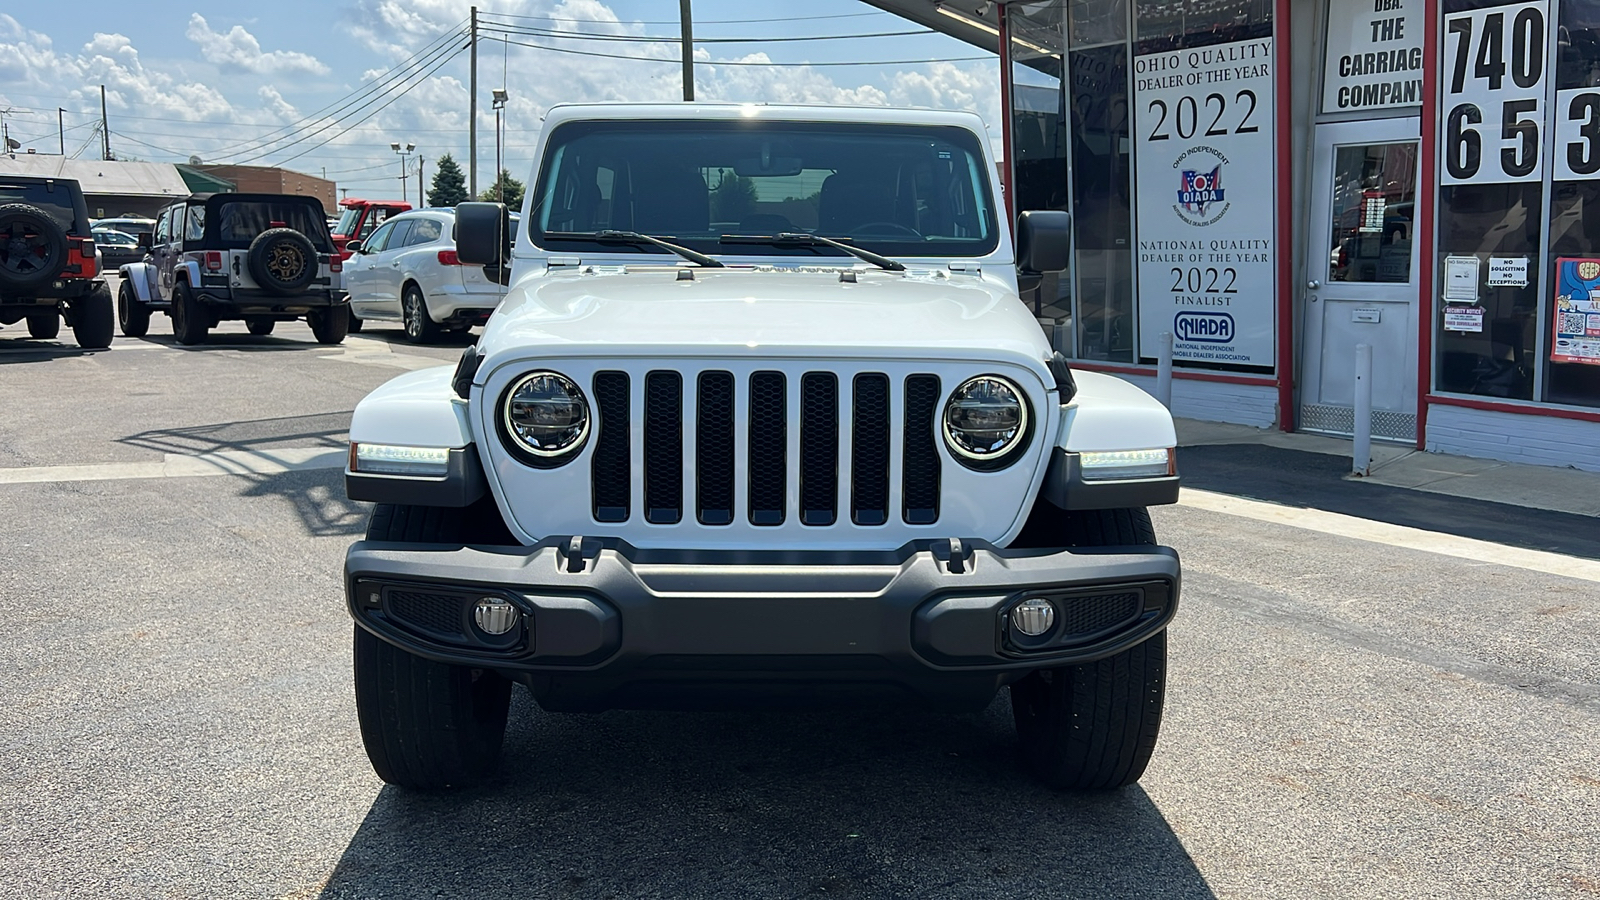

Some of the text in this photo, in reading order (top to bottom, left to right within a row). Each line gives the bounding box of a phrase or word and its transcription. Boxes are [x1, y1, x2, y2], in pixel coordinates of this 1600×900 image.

[1370, 17, 1405, 42] THE
[1136, 42, 1271, 74] OHIO QUALITY
[1339, 47, 1424, 77] CARRIAG
[1448, 6, 1544, 94] 740
[1138, 64, 1269, 91] DEALER OF THE YEAR
[1337, 79, 1424, 108] COMPANY
[1148, 89, 1259, 141] 2022
[1172, 146, 1230, 169] OHIO INDEPENDENT
[1183, 190, 1217, 202] OIADA
[1140, 240, 1270, 251] NATIONAL QUALITY
[1142, 253, 1268, 263] DEALER OF THE YEAR
[1170, 267, 1238, 294] 2022
[1175, 296, 1232, 306] FINALIST
[1179, 317, 1229, 337] NIADA
[1215, 353, 1251, 361] ASSOCIATION
